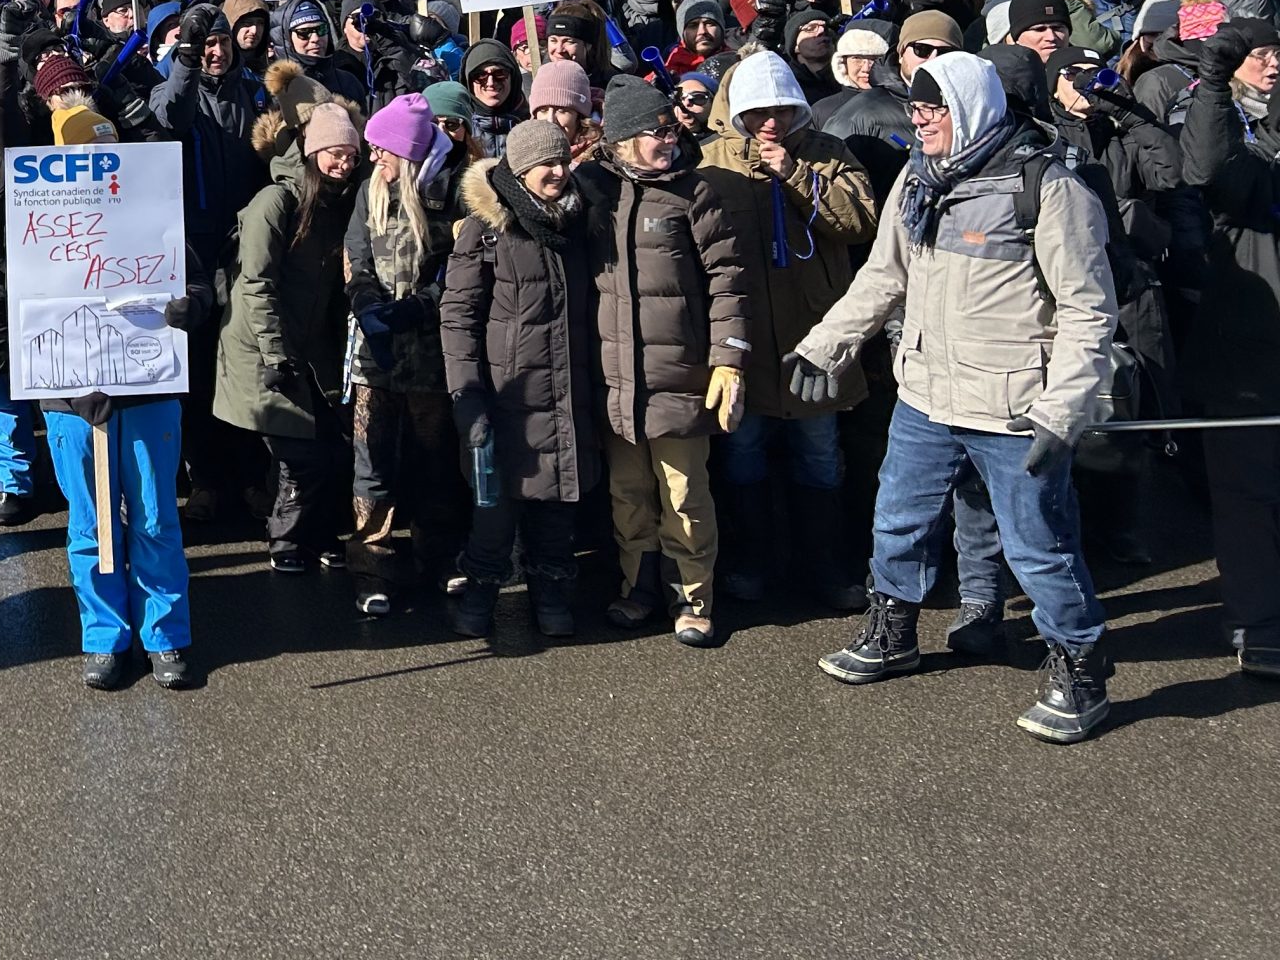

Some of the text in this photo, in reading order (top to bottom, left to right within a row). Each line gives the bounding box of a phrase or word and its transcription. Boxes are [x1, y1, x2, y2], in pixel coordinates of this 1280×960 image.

[13, 152, 121, 184] SCFP
[13, 187, 91, 199] Syndicat canadien
[23, 196, 102, 207] fonction publique
[22, 211, 108, 245] ASSEZ
[49, 239, 177, 290] C'EST ASSEZ!
